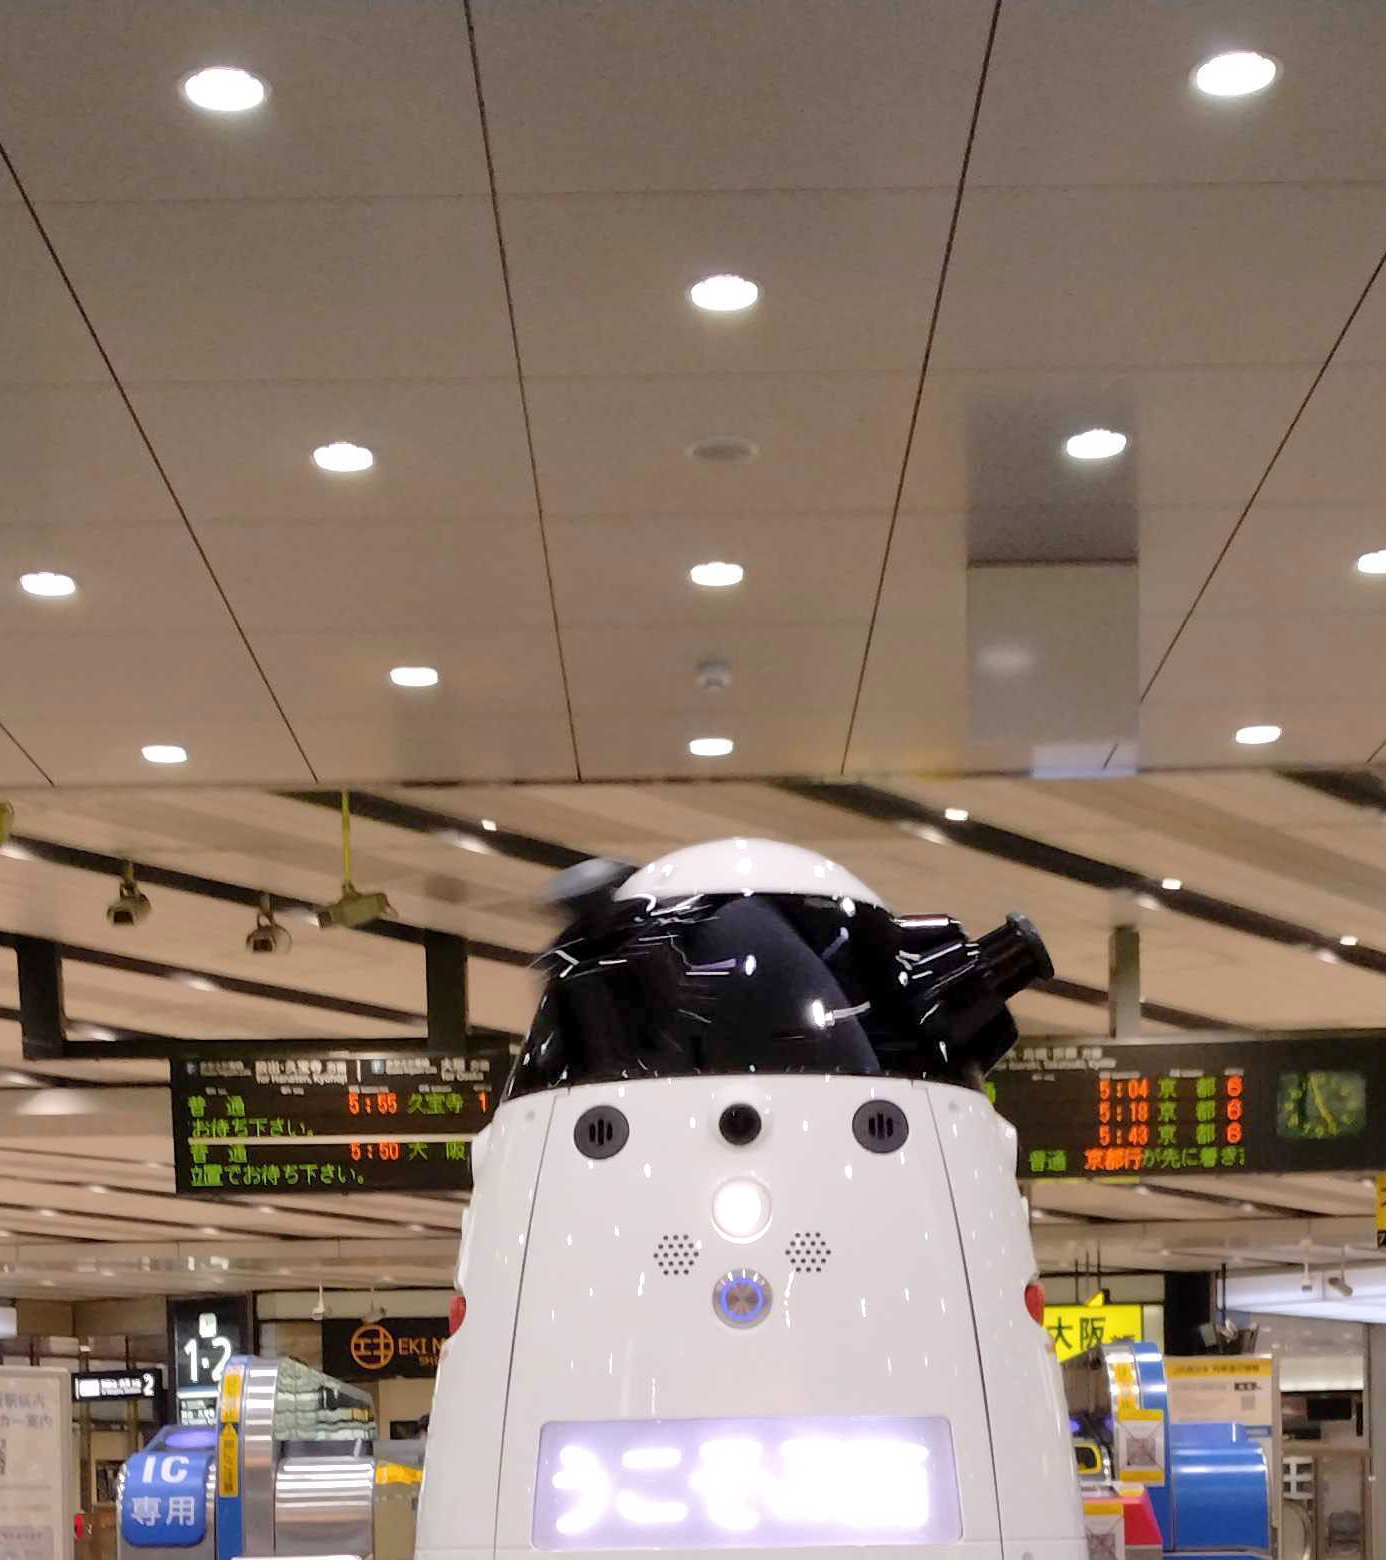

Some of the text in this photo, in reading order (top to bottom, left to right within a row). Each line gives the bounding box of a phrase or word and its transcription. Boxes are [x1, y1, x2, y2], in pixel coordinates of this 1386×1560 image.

[478, 1090, 488, 1113] 1
[398, 1337, 427, 1355] EKI
[143, 1373, 154, 1396] 2
[142, 1455, 190, 1484] IC
[130, 1495, 196, 1527] 専用
